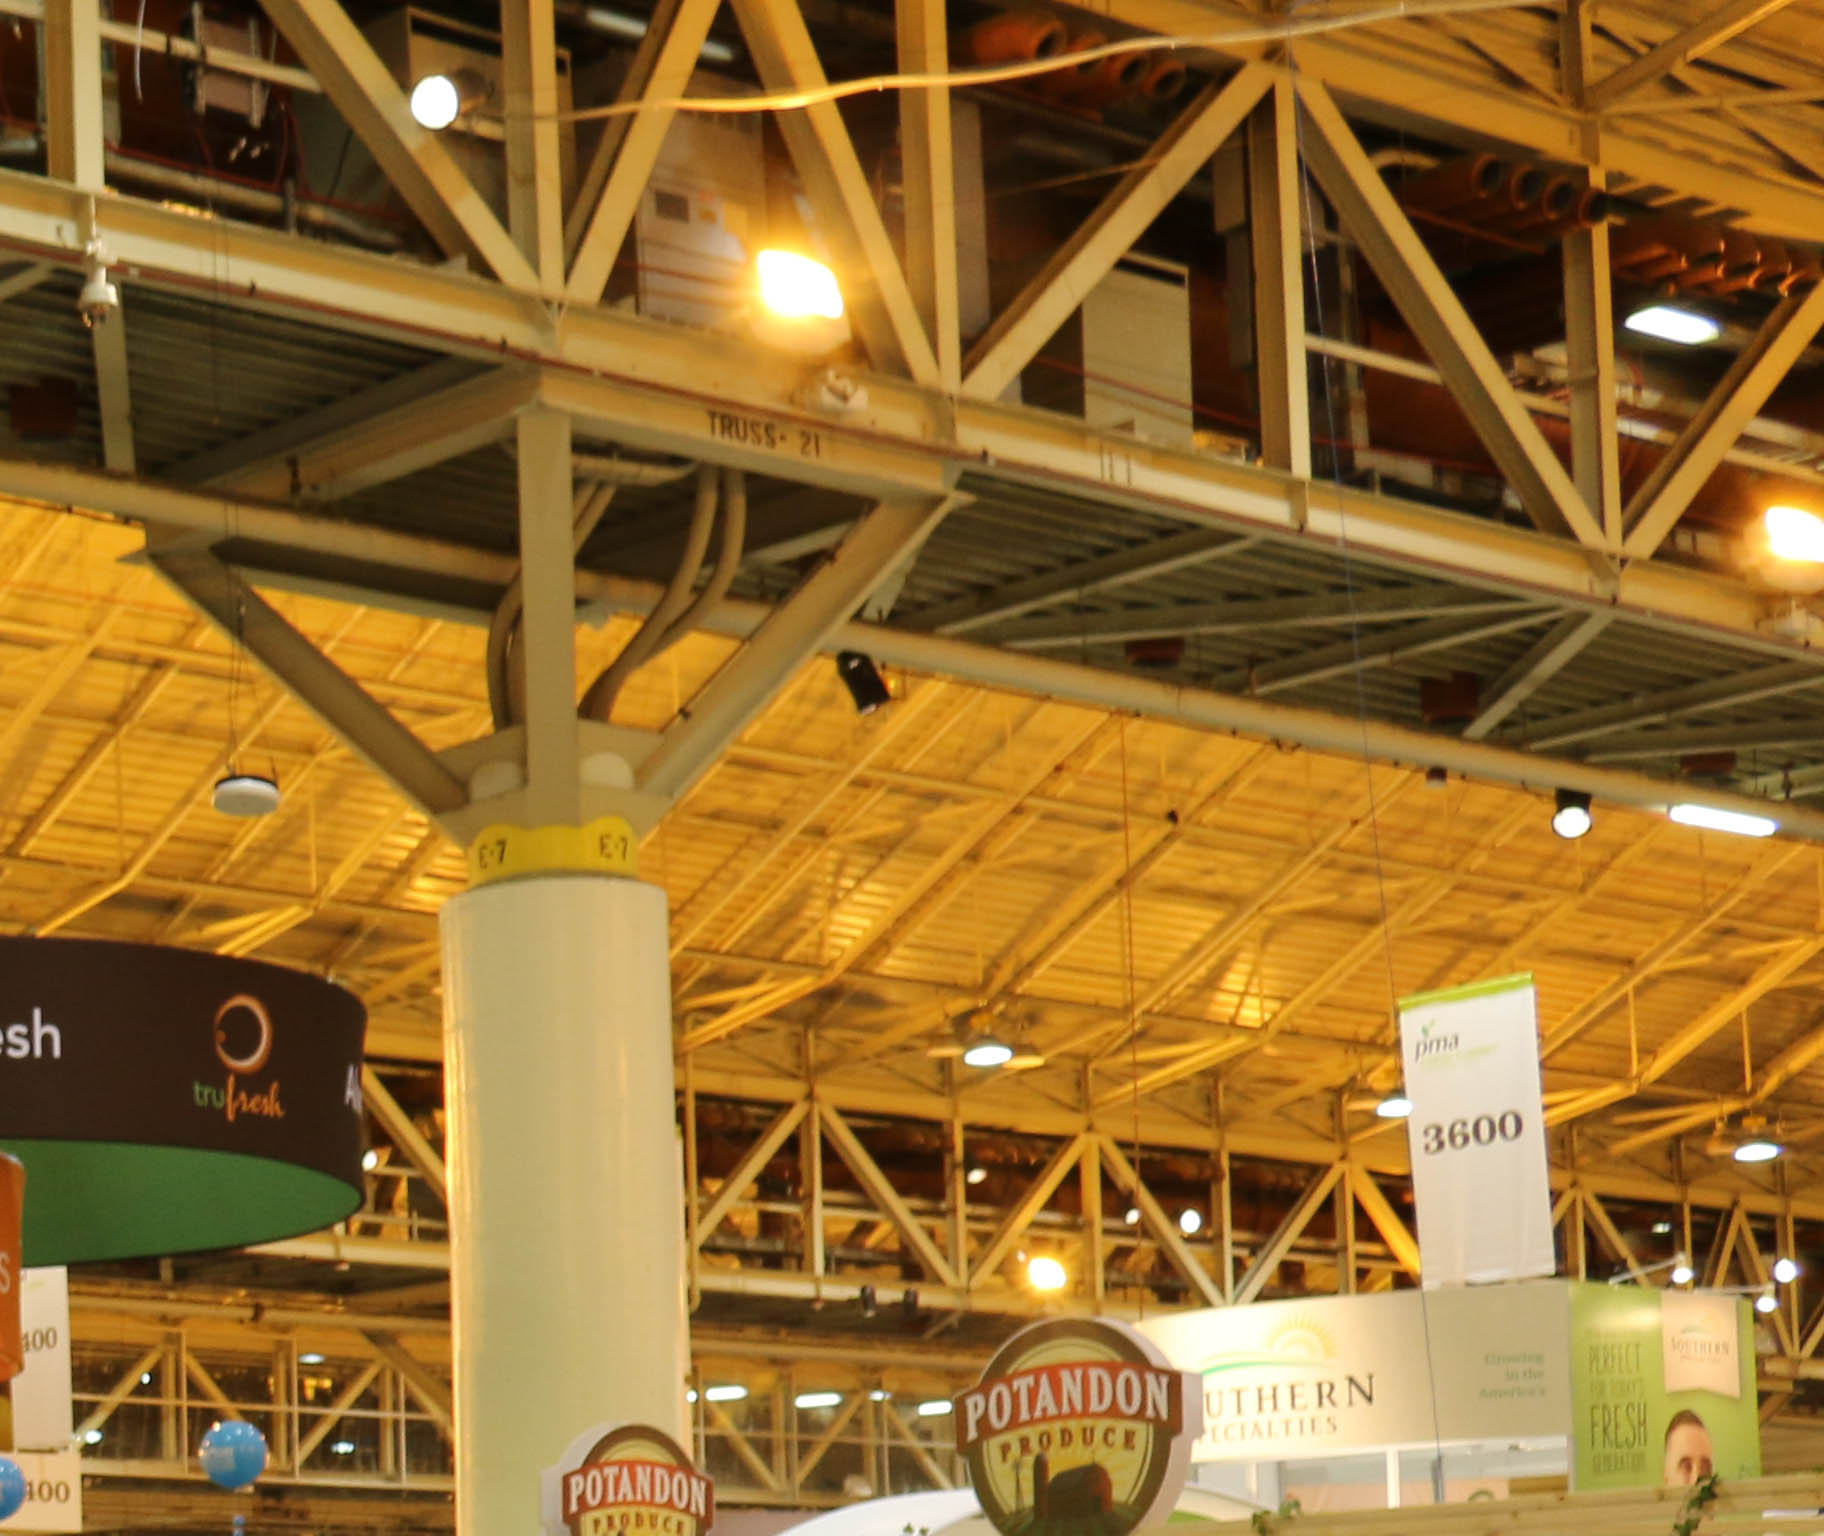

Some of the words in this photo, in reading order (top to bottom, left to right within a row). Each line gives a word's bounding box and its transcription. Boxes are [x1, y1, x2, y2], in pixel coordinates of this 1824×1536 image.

[1415, 1033, 1459, 1063] pma
[1424, 1110, 1523, 1155] 3600
[965, 1367, 1170, 1443] POTANDON
[1205, 1373, 1375, 1419] UTHERN
[1000, 1427, 1136, 1464] PRODUCE
[1202, 1416, 1338, 1444] ECIALTIES
[1590, 1401, 1648, 1451] FRESH
[569, 1465, 706, 1518] POTANDON
[593, 1513, 685, 1536] PRODUCE
